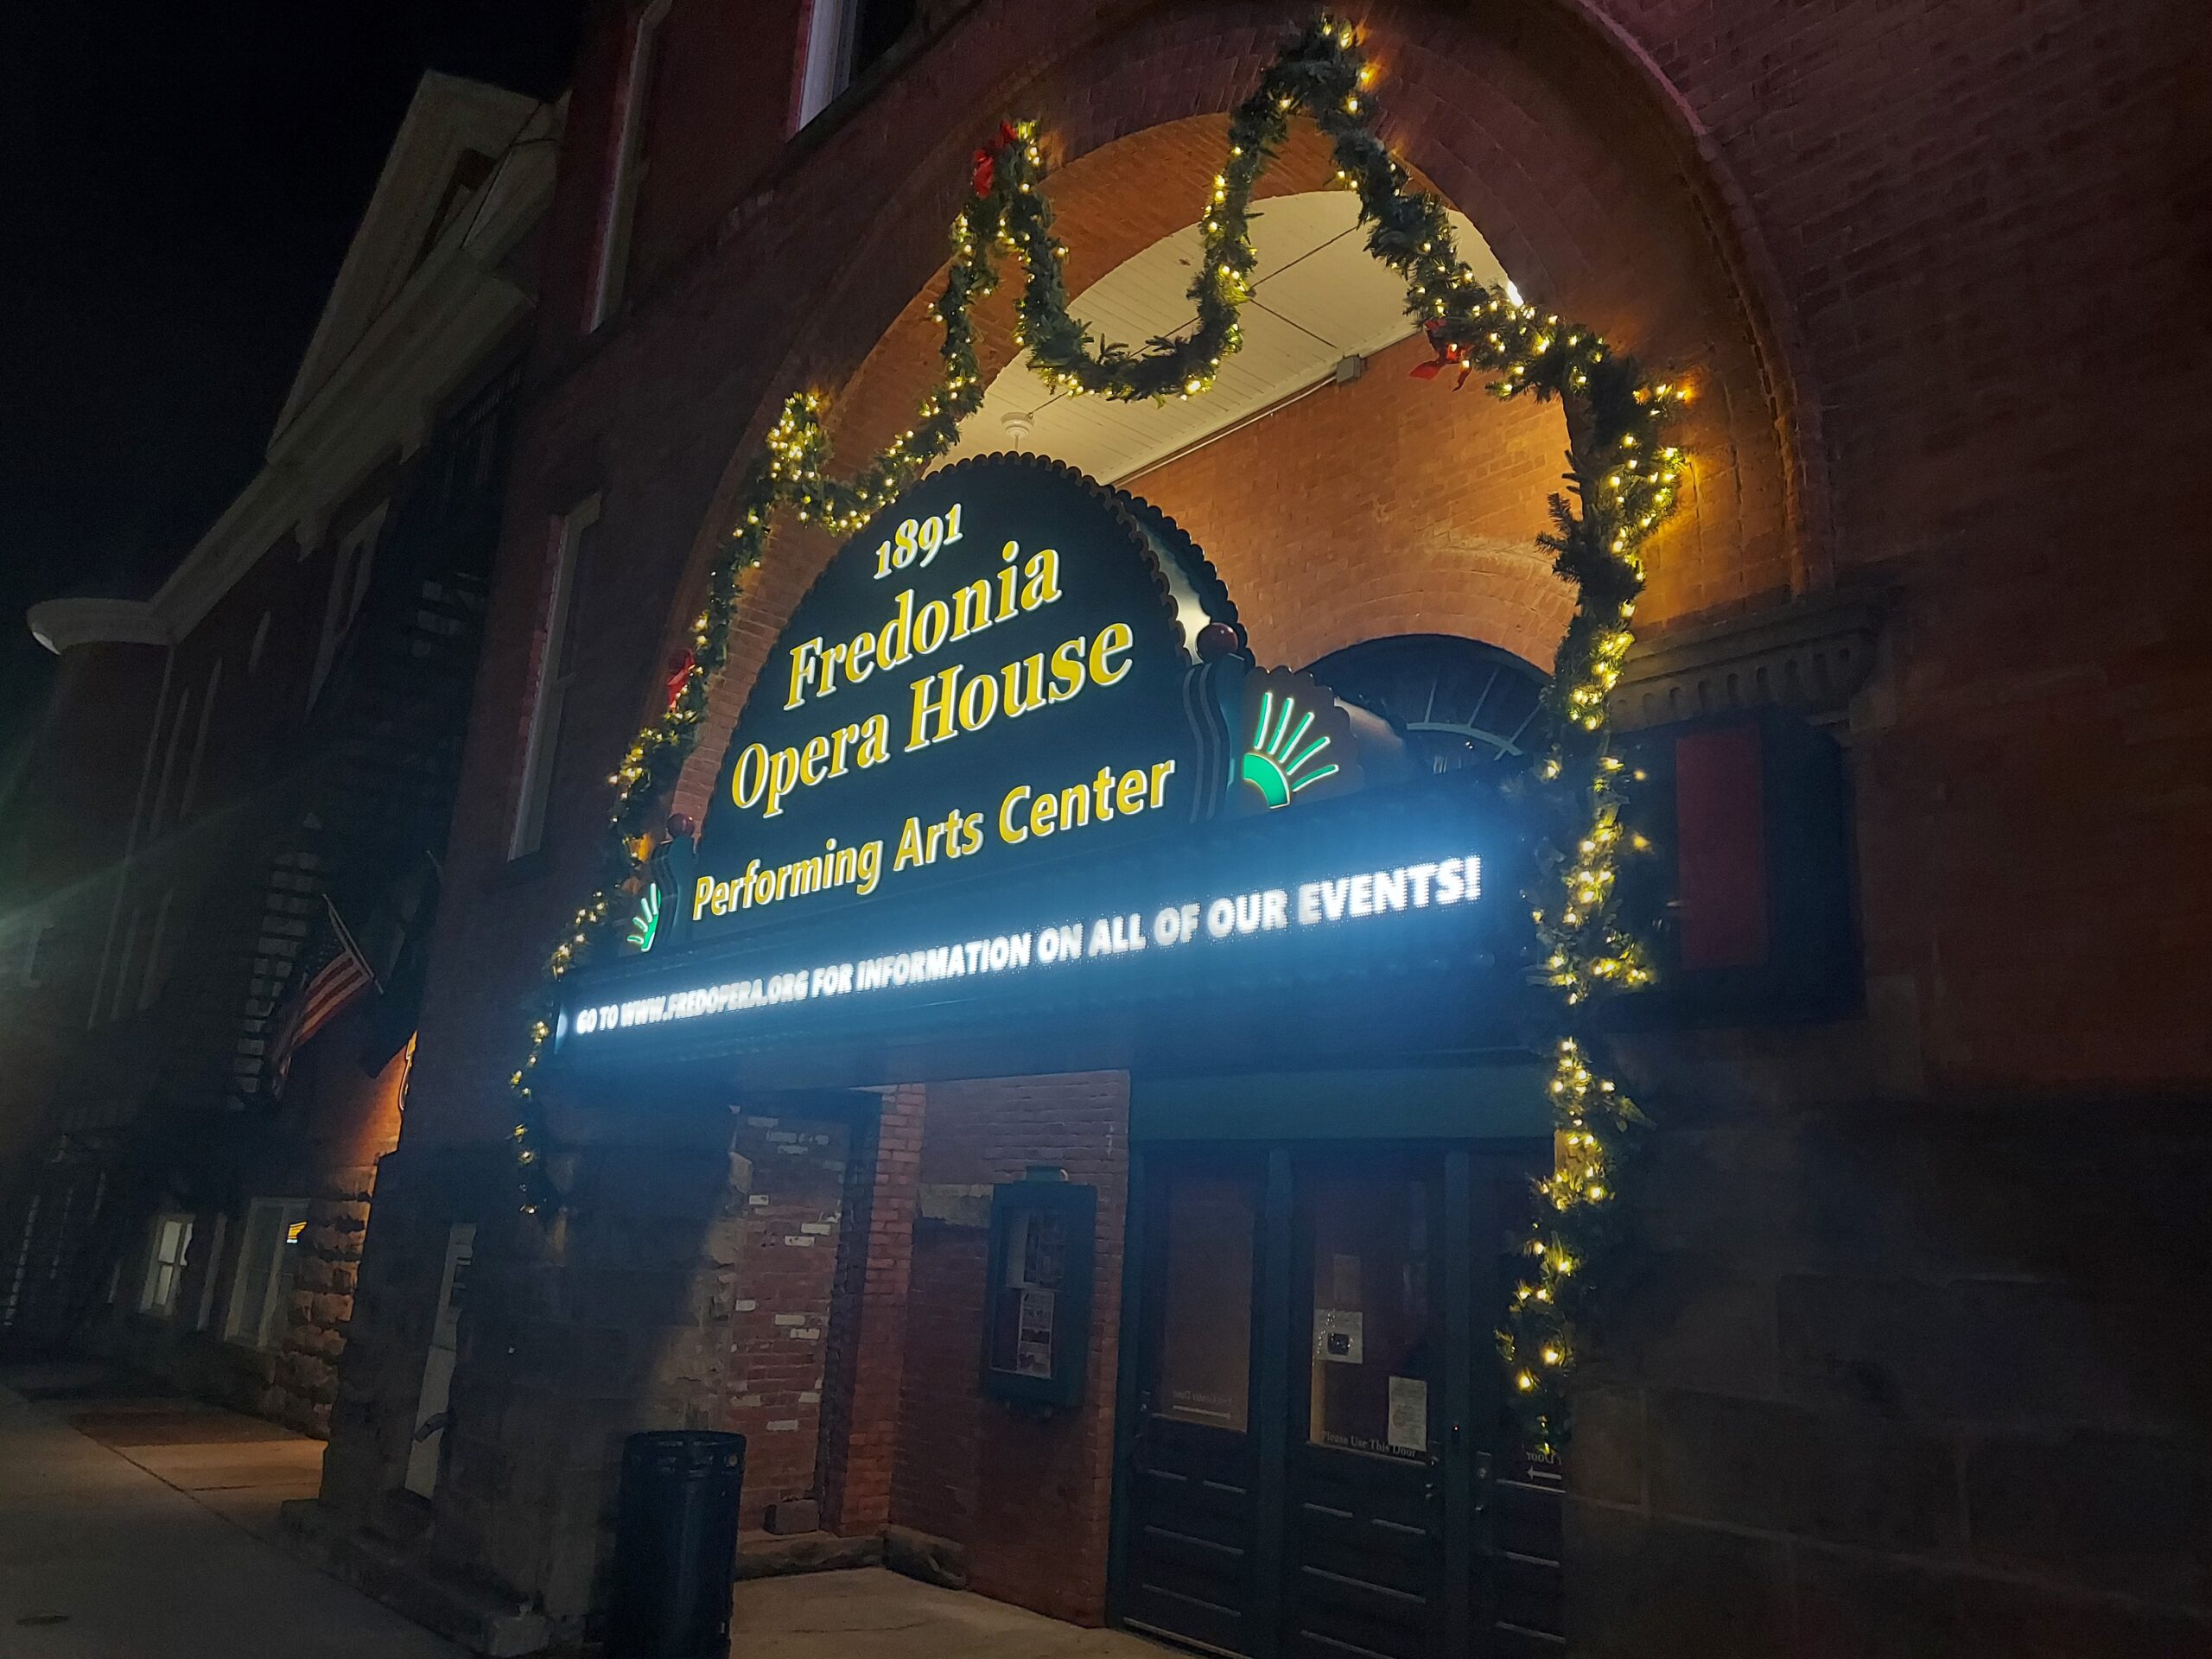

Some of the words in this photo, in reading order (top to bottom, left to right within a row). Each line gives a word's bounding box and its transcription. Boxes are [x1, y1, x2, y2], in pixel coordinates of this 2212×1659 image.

[873, 503, 963, 580] 1891
[783, 540, 1063, 711] Fredonia
[731, 711, 890, 819] Opera
[903, 621, 1134, 754] House
[691, 837, 885, 922] Performing
[893, 807, 984, 872] Arts
[998, 758, 1176, 844] Center
[576, 1007, 598, 1034] GO
[599, 1004, 620, 1031] TO
[620, 969, 810, 1027] WWW.FREDOPERA.ORG
[811, 962, 854, 999] FOR
[855, 931, 1033, 993] INFORMATION
[1038, 921, 1084, 965] ON
[1087, 912, 1147, 957] ALL
[1154, 901, 1201, 947] OF
[1207, 888, 1289, 939] OUR
[1297, 854, 1482, 926] EVENTS!
[1322, 1430, 1349, 1445] Please
[1351, 1435, 1368, 1449] Use
[1370, 1438, 1390, 1452] This
[1392, 1445, 1417, 1459] Door
